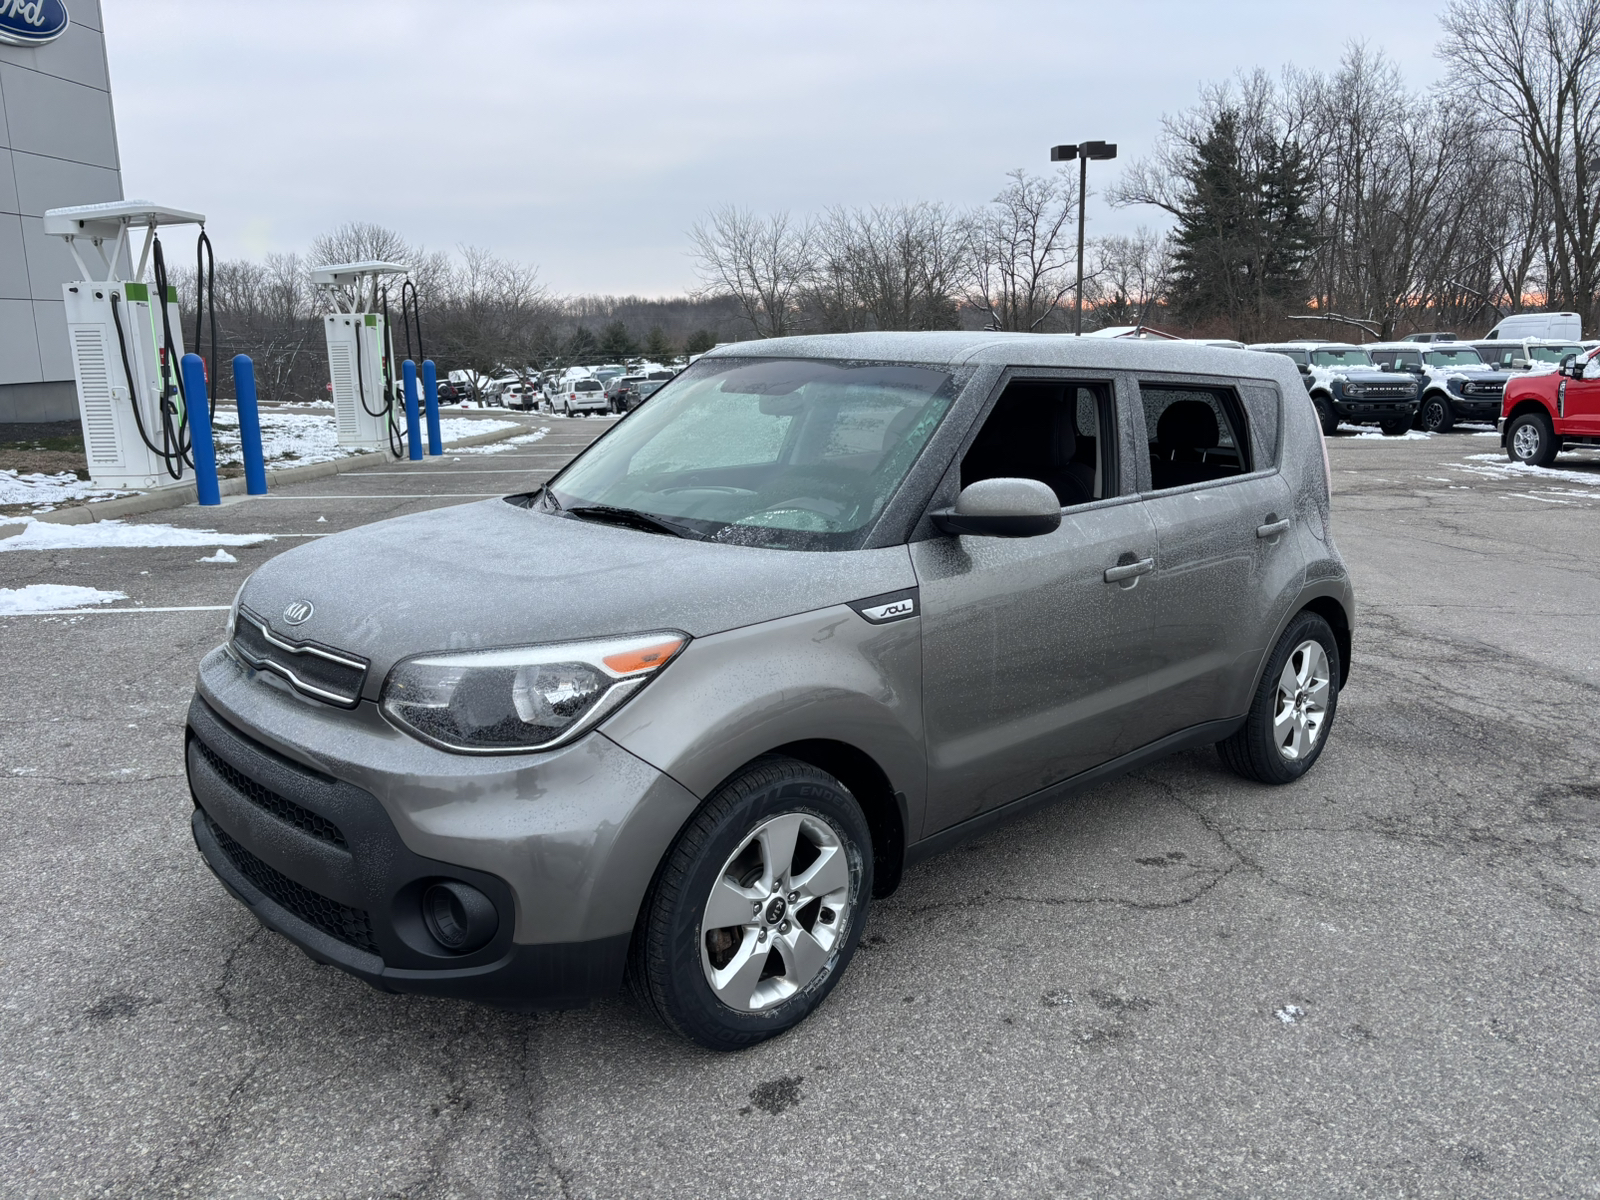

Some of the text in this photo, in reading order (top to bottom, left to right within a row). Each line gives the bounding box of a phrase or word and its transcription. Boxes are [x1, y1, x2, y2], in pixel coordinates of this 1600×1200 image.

[0, 0, 46, 27] ord
[799, 785, 867, 842] ENDEAVO
[769, 900, 784, 921] KIA
